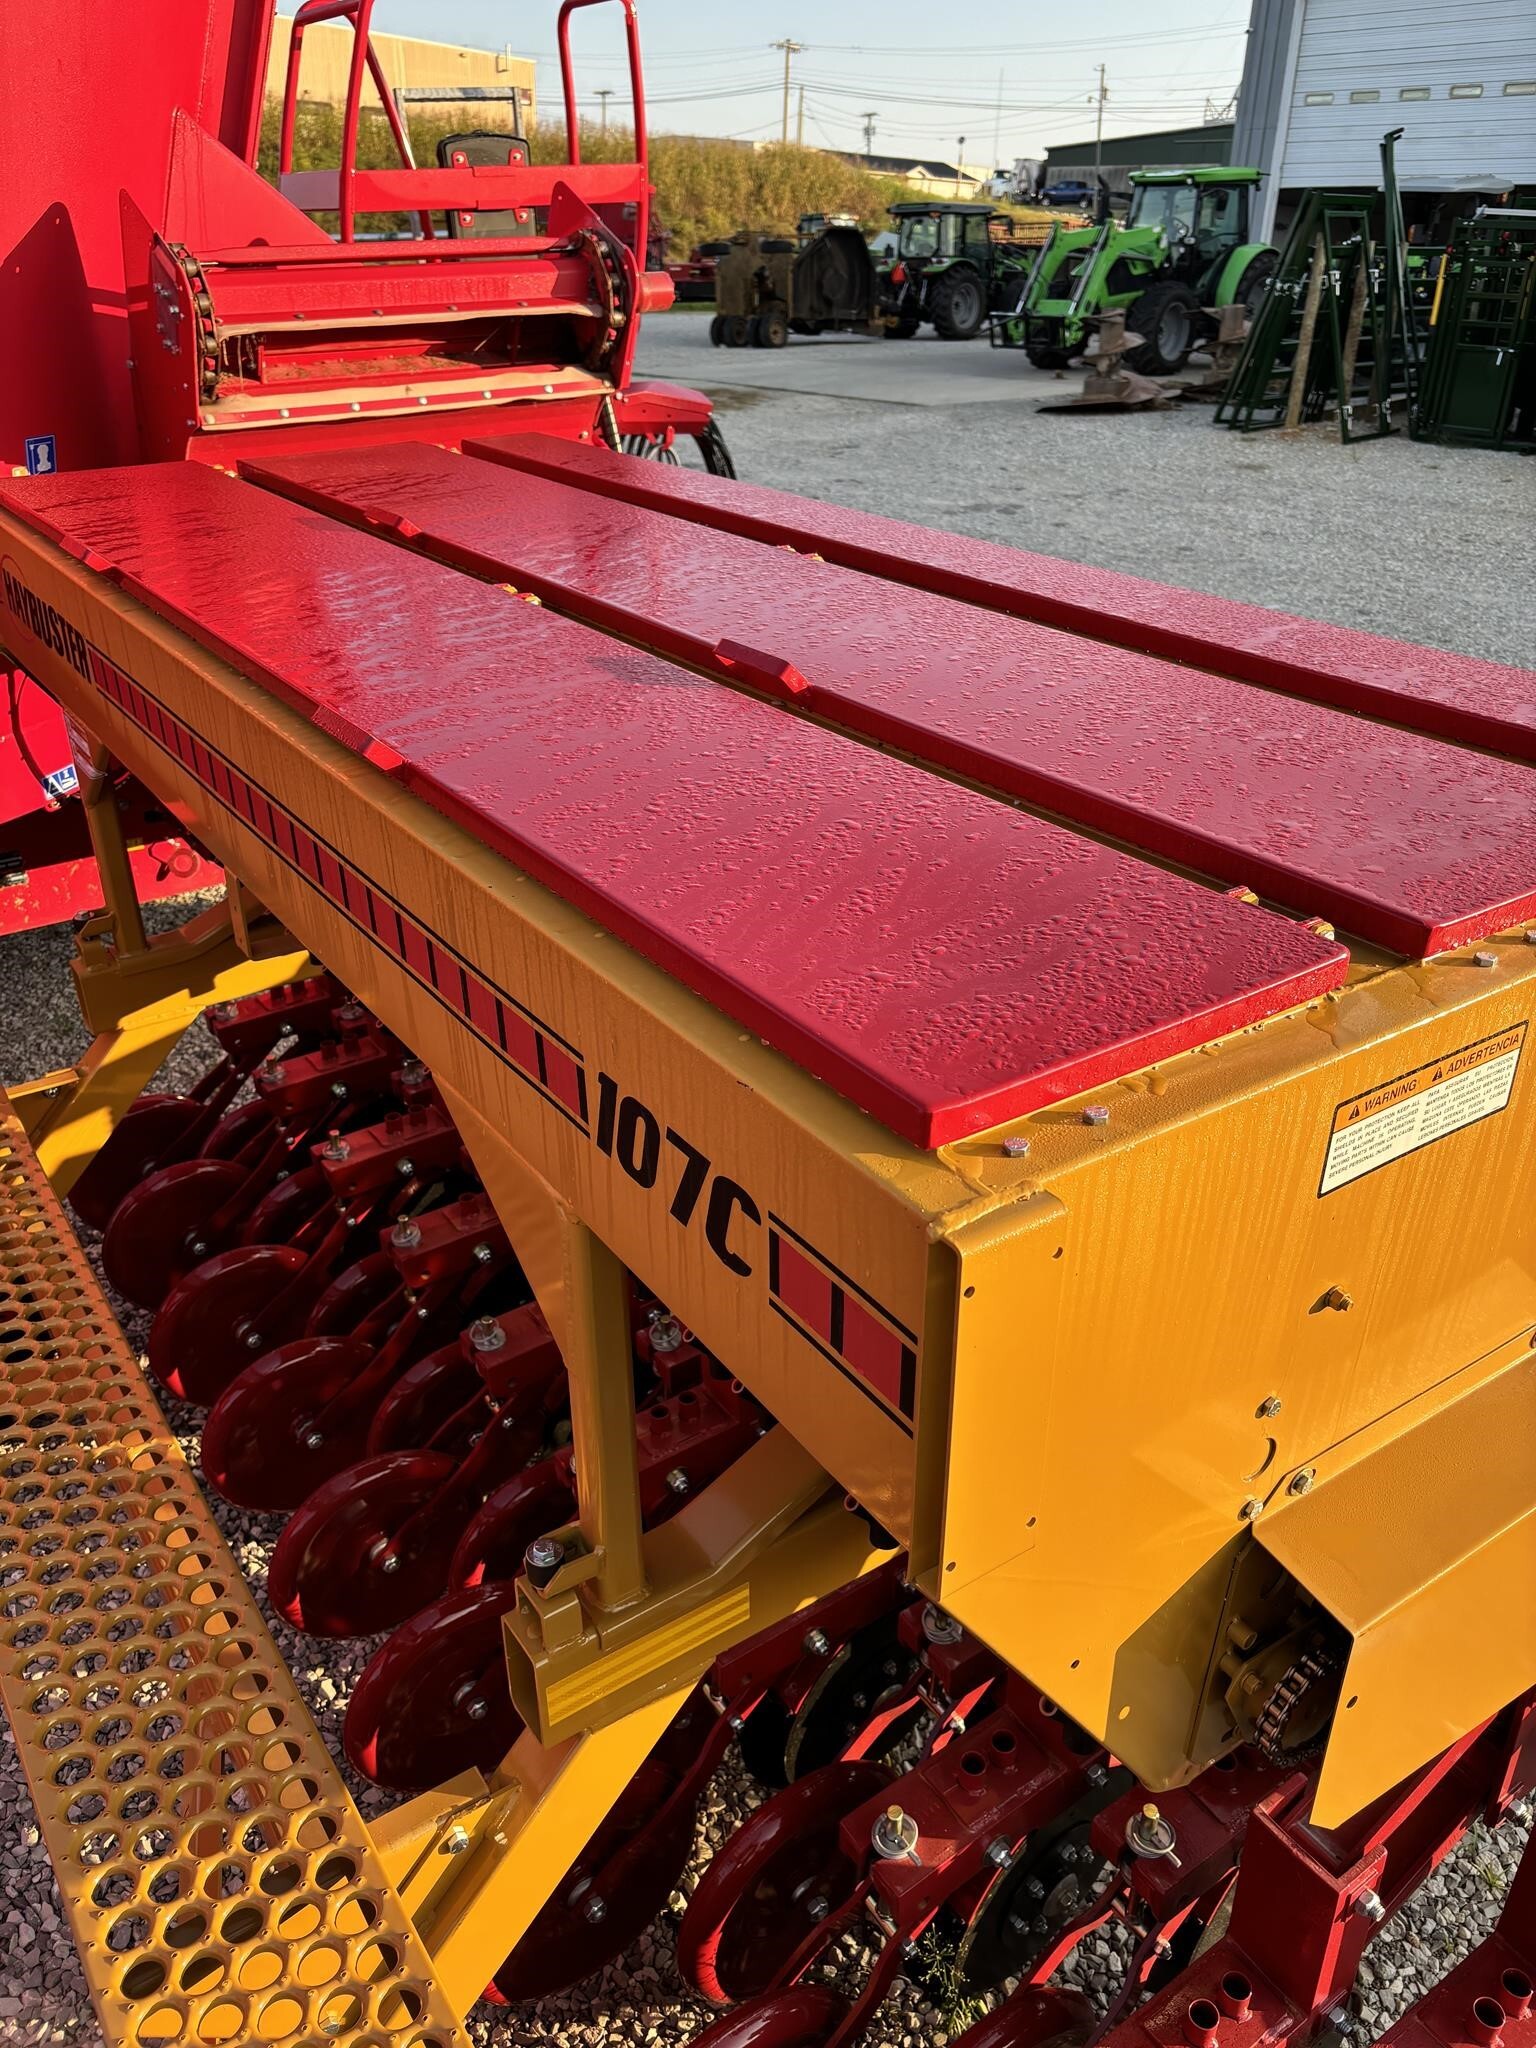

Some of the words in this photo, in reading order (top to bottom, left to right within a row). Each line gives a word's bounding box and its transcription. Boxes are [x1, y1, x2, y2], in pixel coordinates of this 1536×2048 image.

[3, 568, 92, 685] HAYBUSTER
[1446, 1033, 1519, 1074] ADVERTENCIA
[1364, 1079, 1417, 1111] WARNING
[1431, 1101, 1446, 1111] LUGAR
[1334, 1138, 1355, 1151] SHIELDS
[1365, 1126, 1381, 1137] PLACE
[1383, 1120, 1393, 1128] AND
[1395, 1108, 1418, 1122] SECURED
[1336, 1135, 1346, 1143] FOR
[1349, 1127, 1362, 1137] YOUR
[1364, 1112, 1395, 1129] PROTECTION
[1397, 1104, 1410, 1113] KEEP
[1328, 1166, 1347, 1178] SEVERE
[1349, 1152, 1374, 1167] PERSONAL
[1330, 1157, 1349, 1169] MOVING
[1351, 1148, 1367, 1158] PARTS
[1368, 1140, 1385, 1150] WITHIN
[1386, 1134, 1397, 1142] CAN
[1398, 1126, 1414, 1136] CAUSE
[1332, 1150, 1348, 1160] WHILE
[1352, 1137, 1374, 1150] MACHINE
[596, 1071, 762, 1277] 107C
